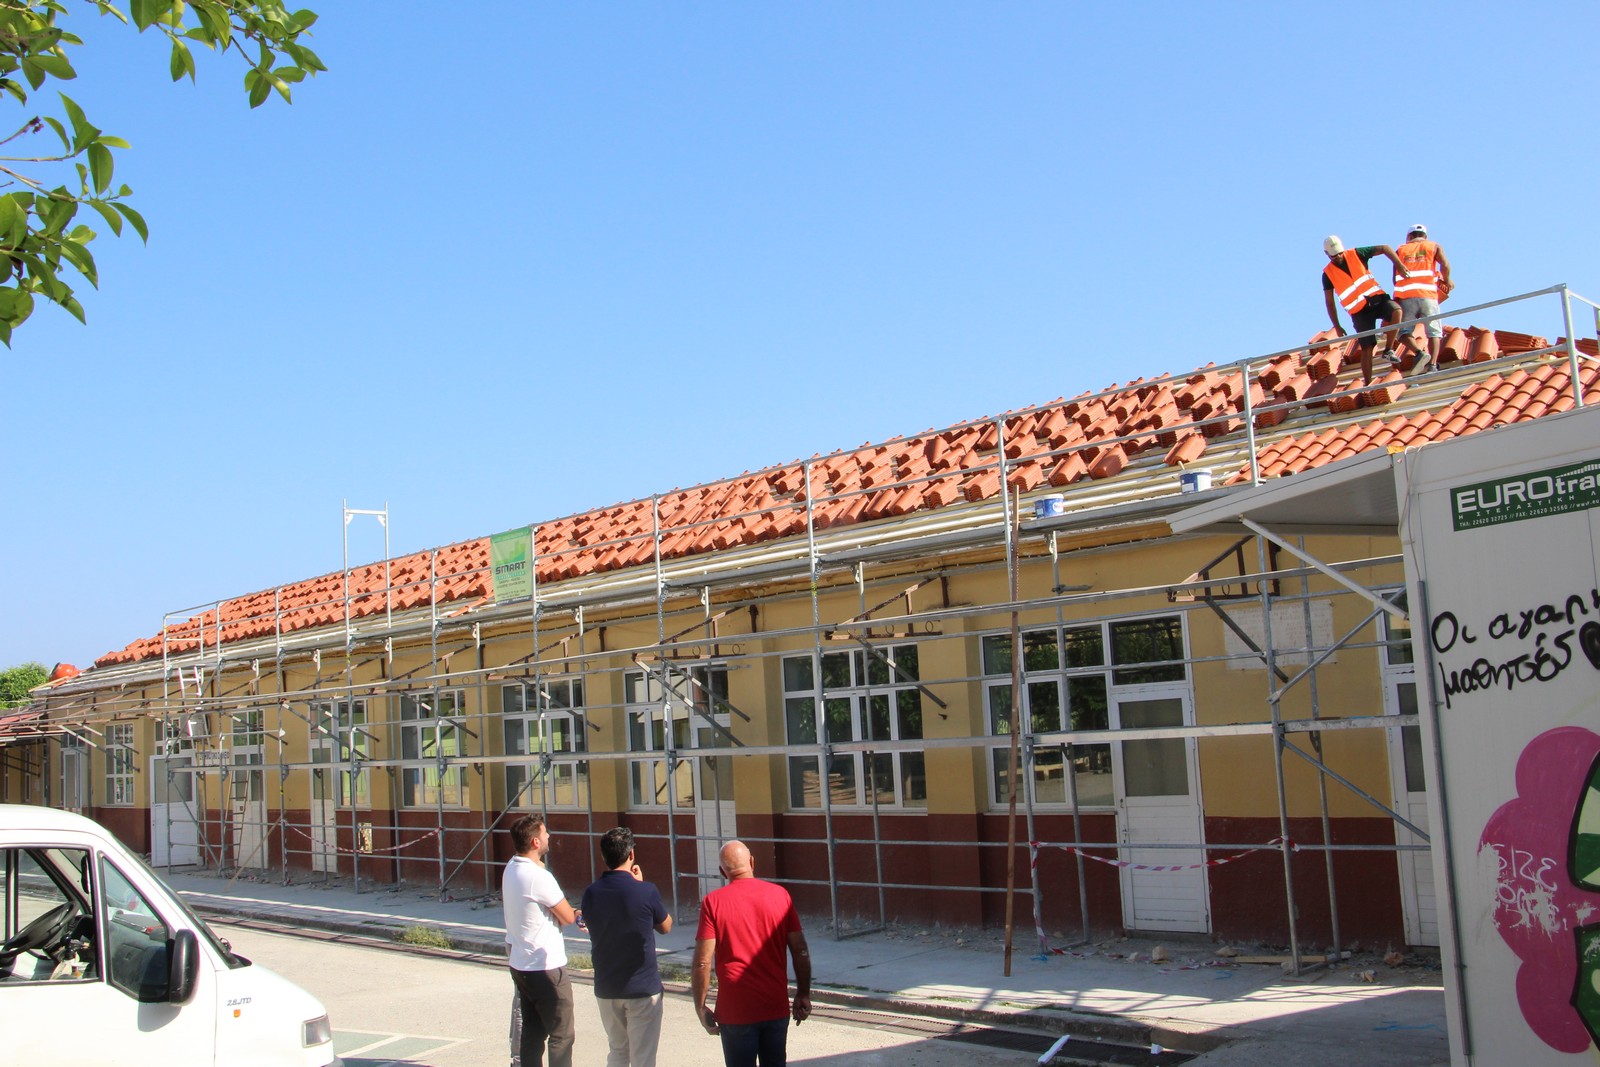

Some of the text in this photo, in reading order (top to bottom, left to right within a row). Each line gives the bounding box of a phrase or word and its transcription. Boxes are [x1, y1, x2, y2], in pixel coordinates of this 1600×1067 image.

[1456, 474, 1600, 513] EUROtra
[1576, 499, 1600, 508] www.eu
[495, 561, 526, 575] SMART
